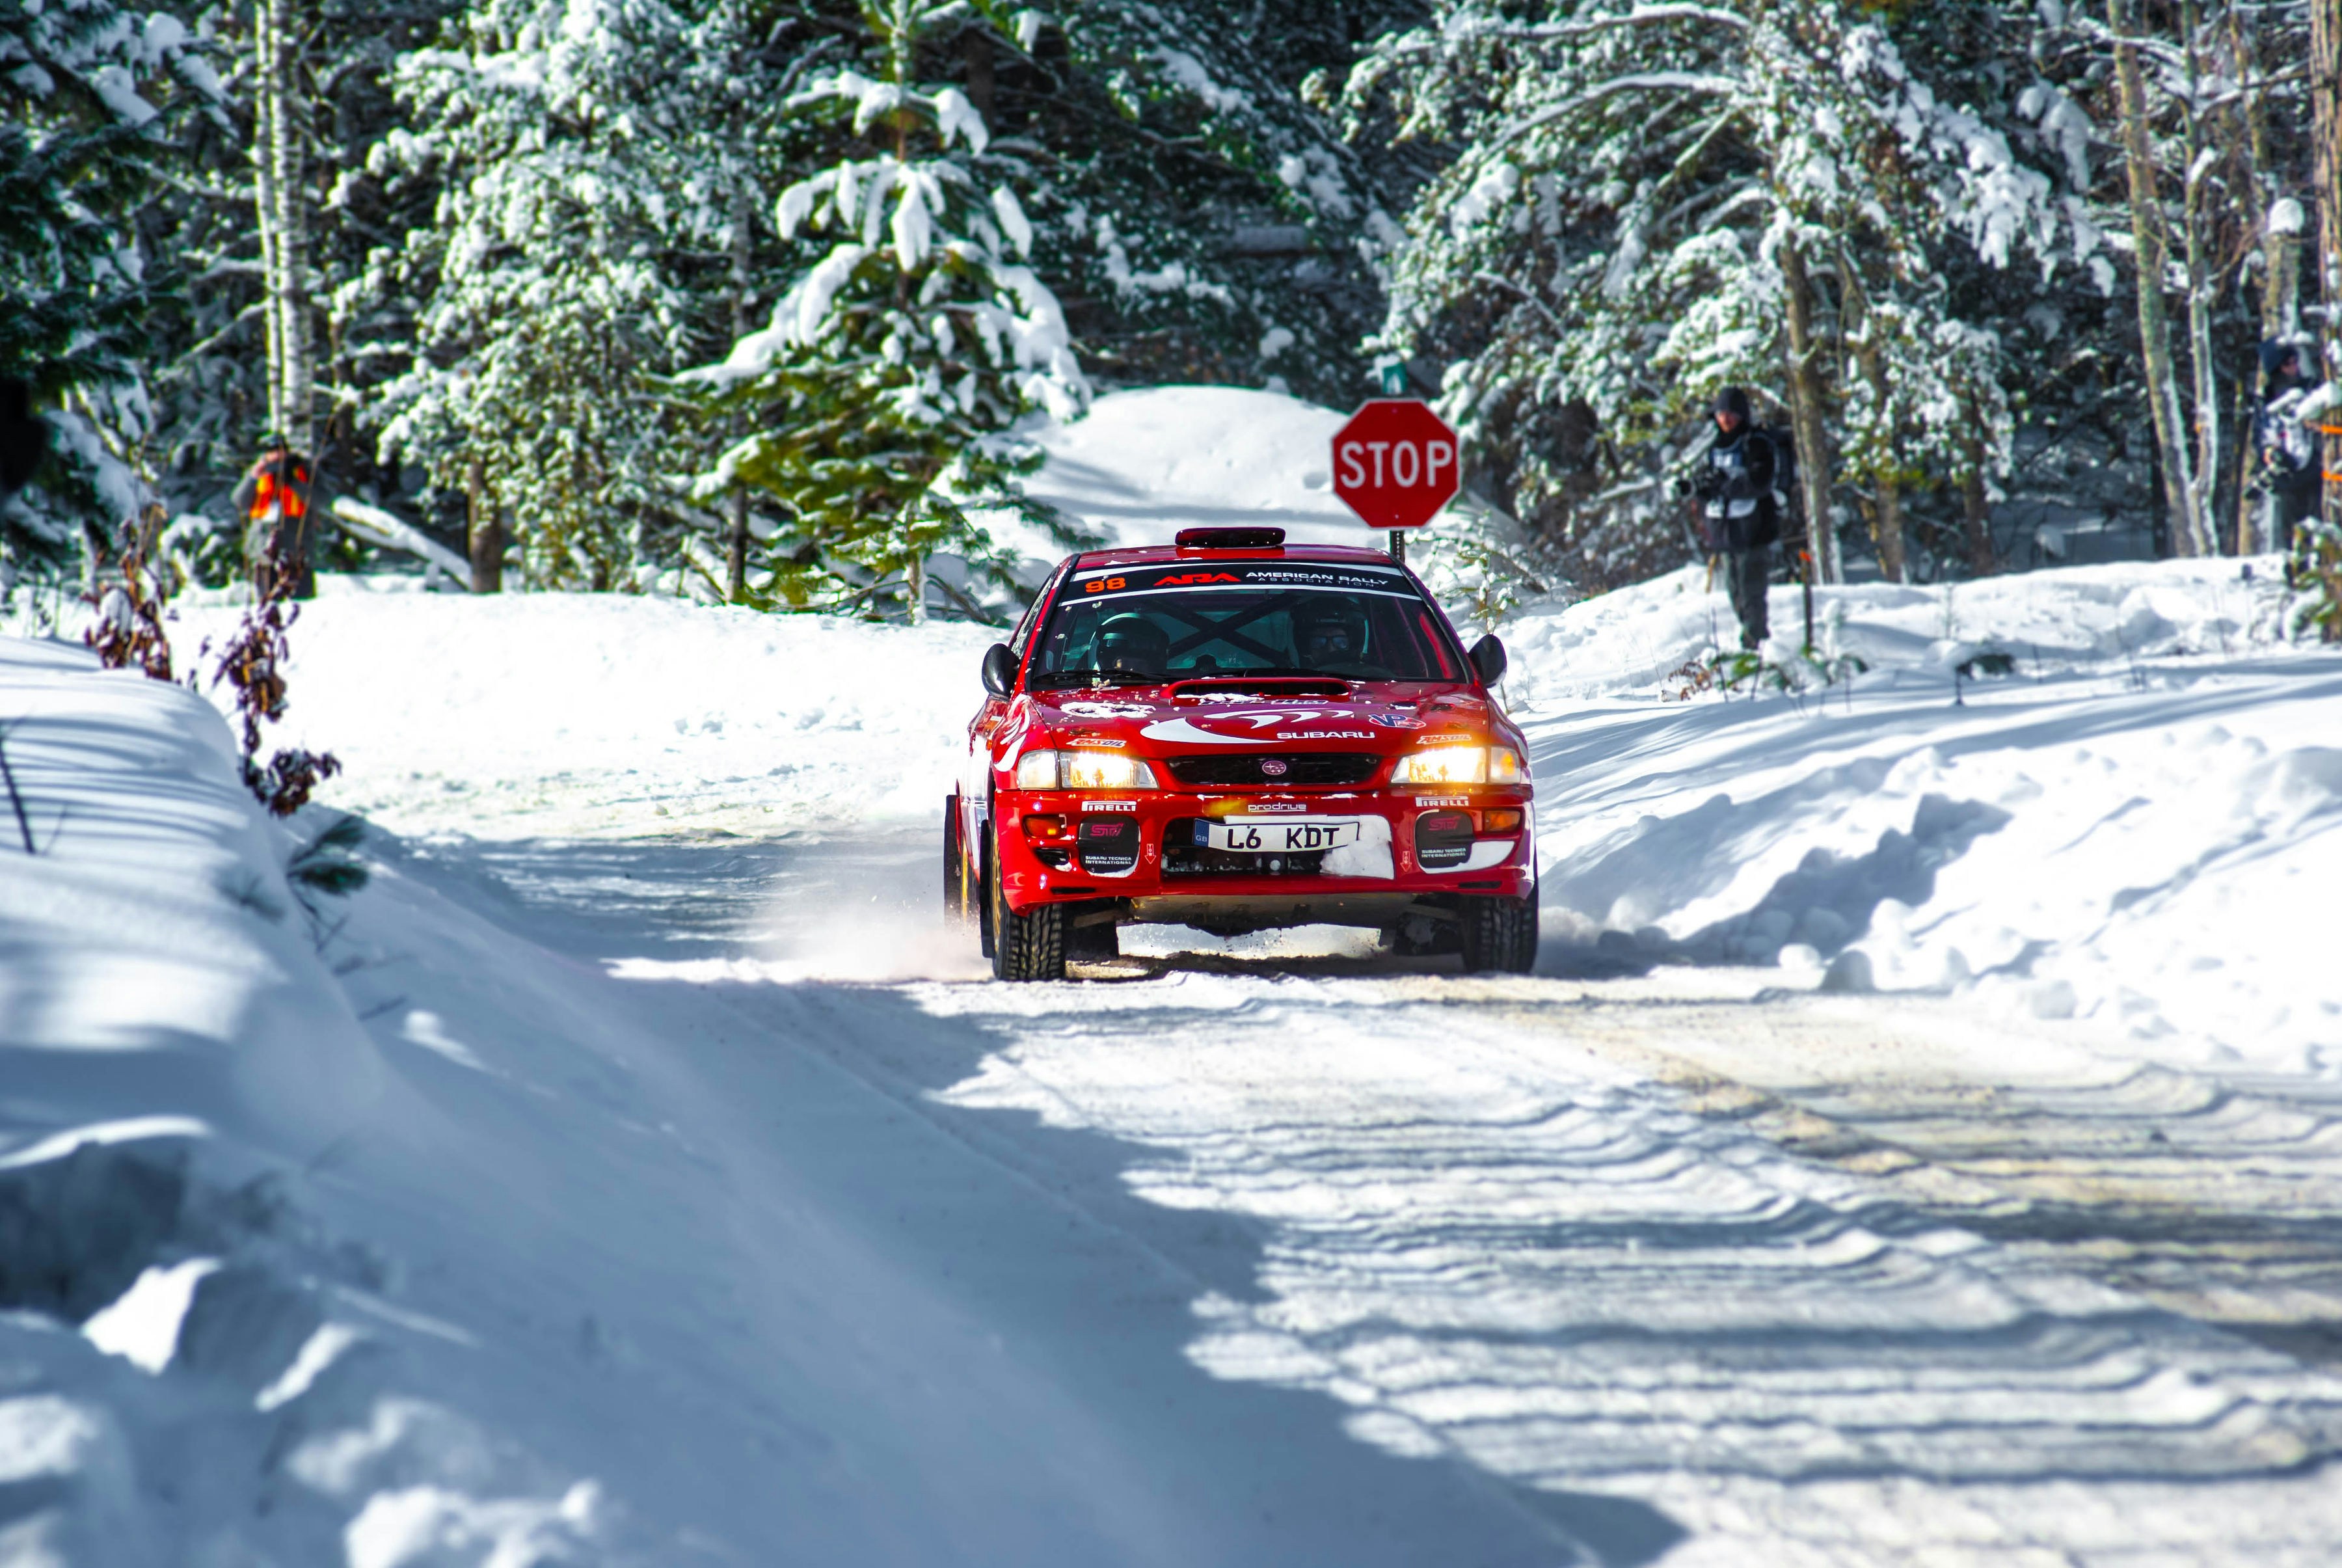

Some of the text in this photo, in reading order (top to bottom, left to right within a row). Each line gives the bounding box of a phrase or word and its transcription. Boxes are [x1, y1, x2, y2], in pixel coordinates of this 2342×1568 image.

[1340, 440, 1453, 488] STOP
[1085, 577, 1125, 593] 98
[1153, 573, 1241, 586] ARA
[1258, 577, 1374, 588] ASSOCIATION
[1339, 576, 1388, 585] RALLY
[1369, 714, 1407, 727] VP
[1081, 801, 1137, 811] PIRELLI
[1248, 802, 1306, 812] prodrive
[1416, 796, 1469, 807] PIRELLI
[1227, 827, 1340, 849] L6 KDT
